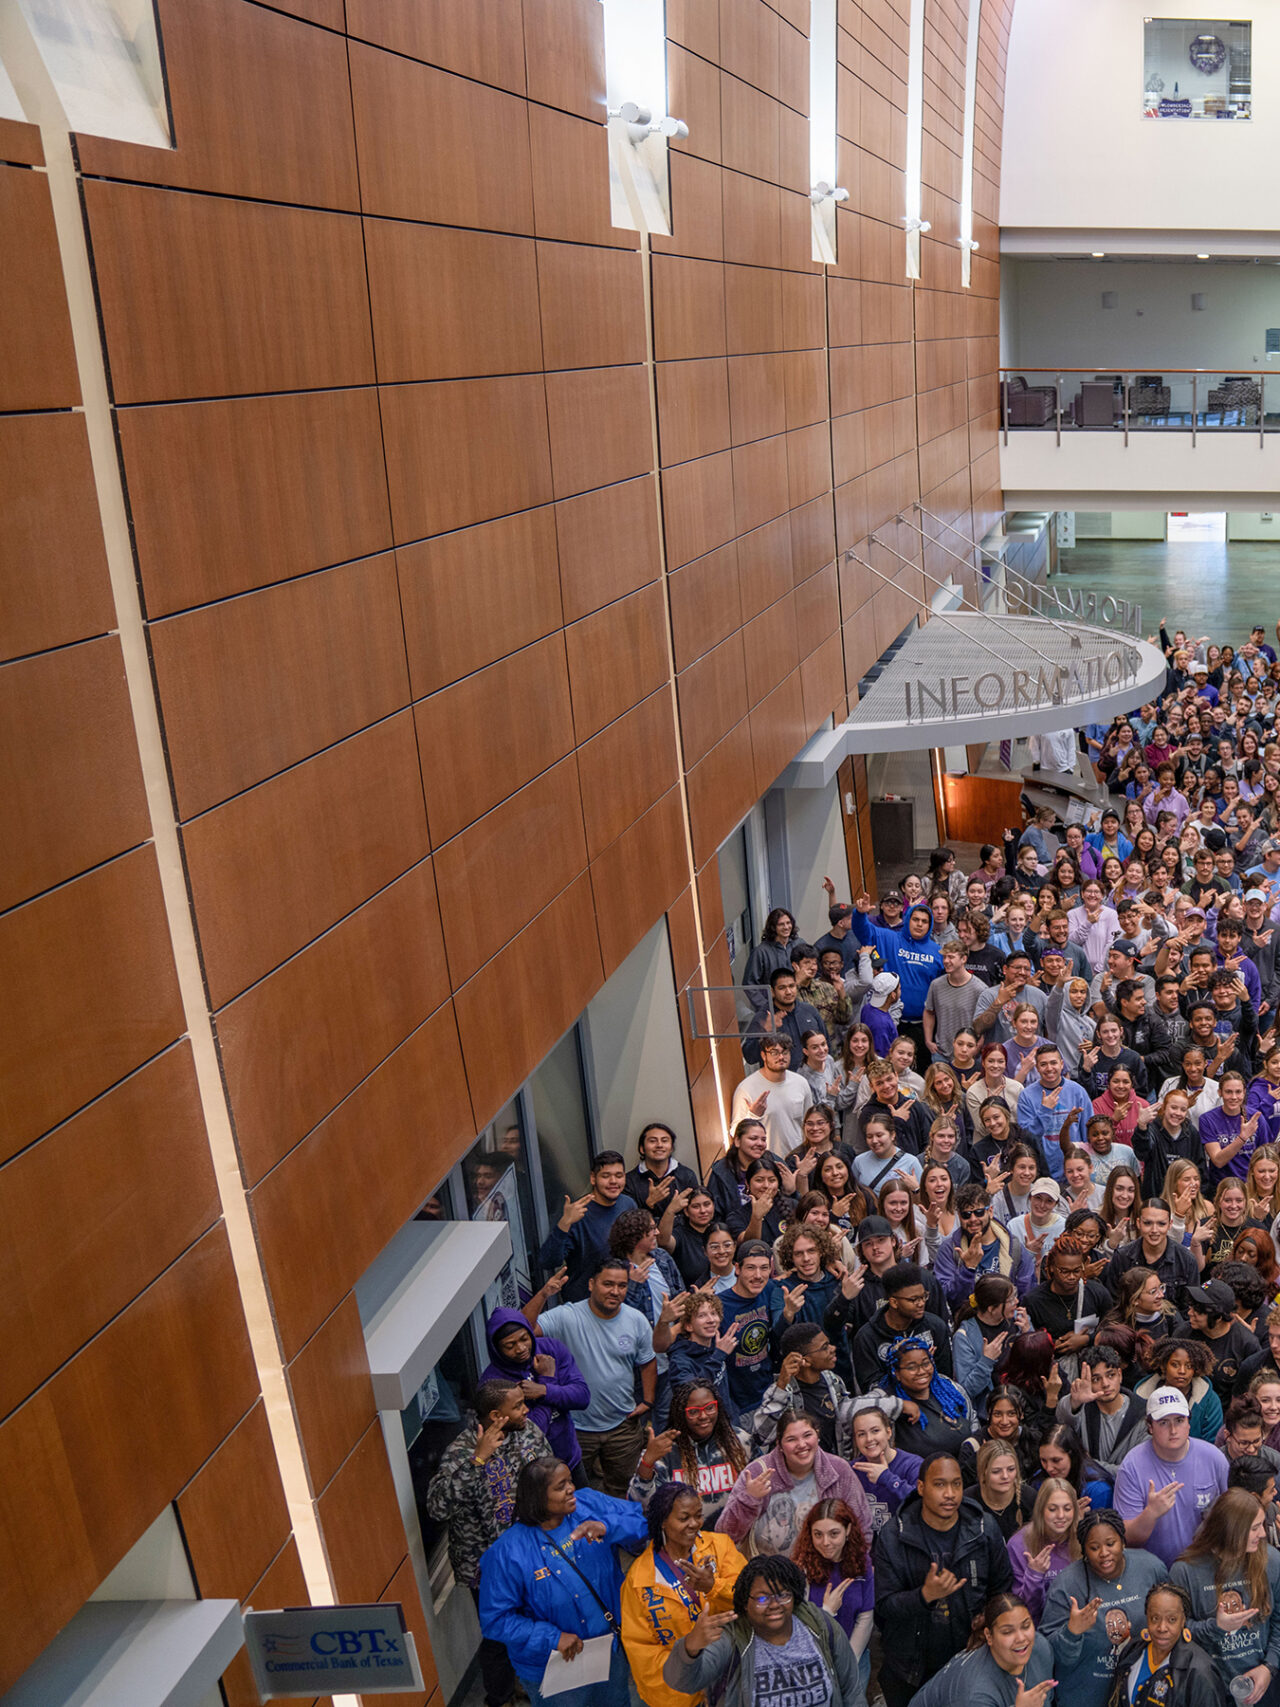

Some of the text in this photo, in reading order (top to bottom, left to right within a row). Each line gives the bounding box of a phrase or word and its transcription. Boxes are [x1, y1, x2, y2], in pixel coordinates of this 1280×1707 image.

[905, 646, 1138, 718] INFORMATION
[898, 948, 919, 961] SOUTH
[1159, 1395, 1176, 1405] SFA
[674, 1464, 735, 1493] MRVEL
[265, 1655, 404, 1673] Commercial Bank of Texas
[755, 1661, 824, 1694] BAND
